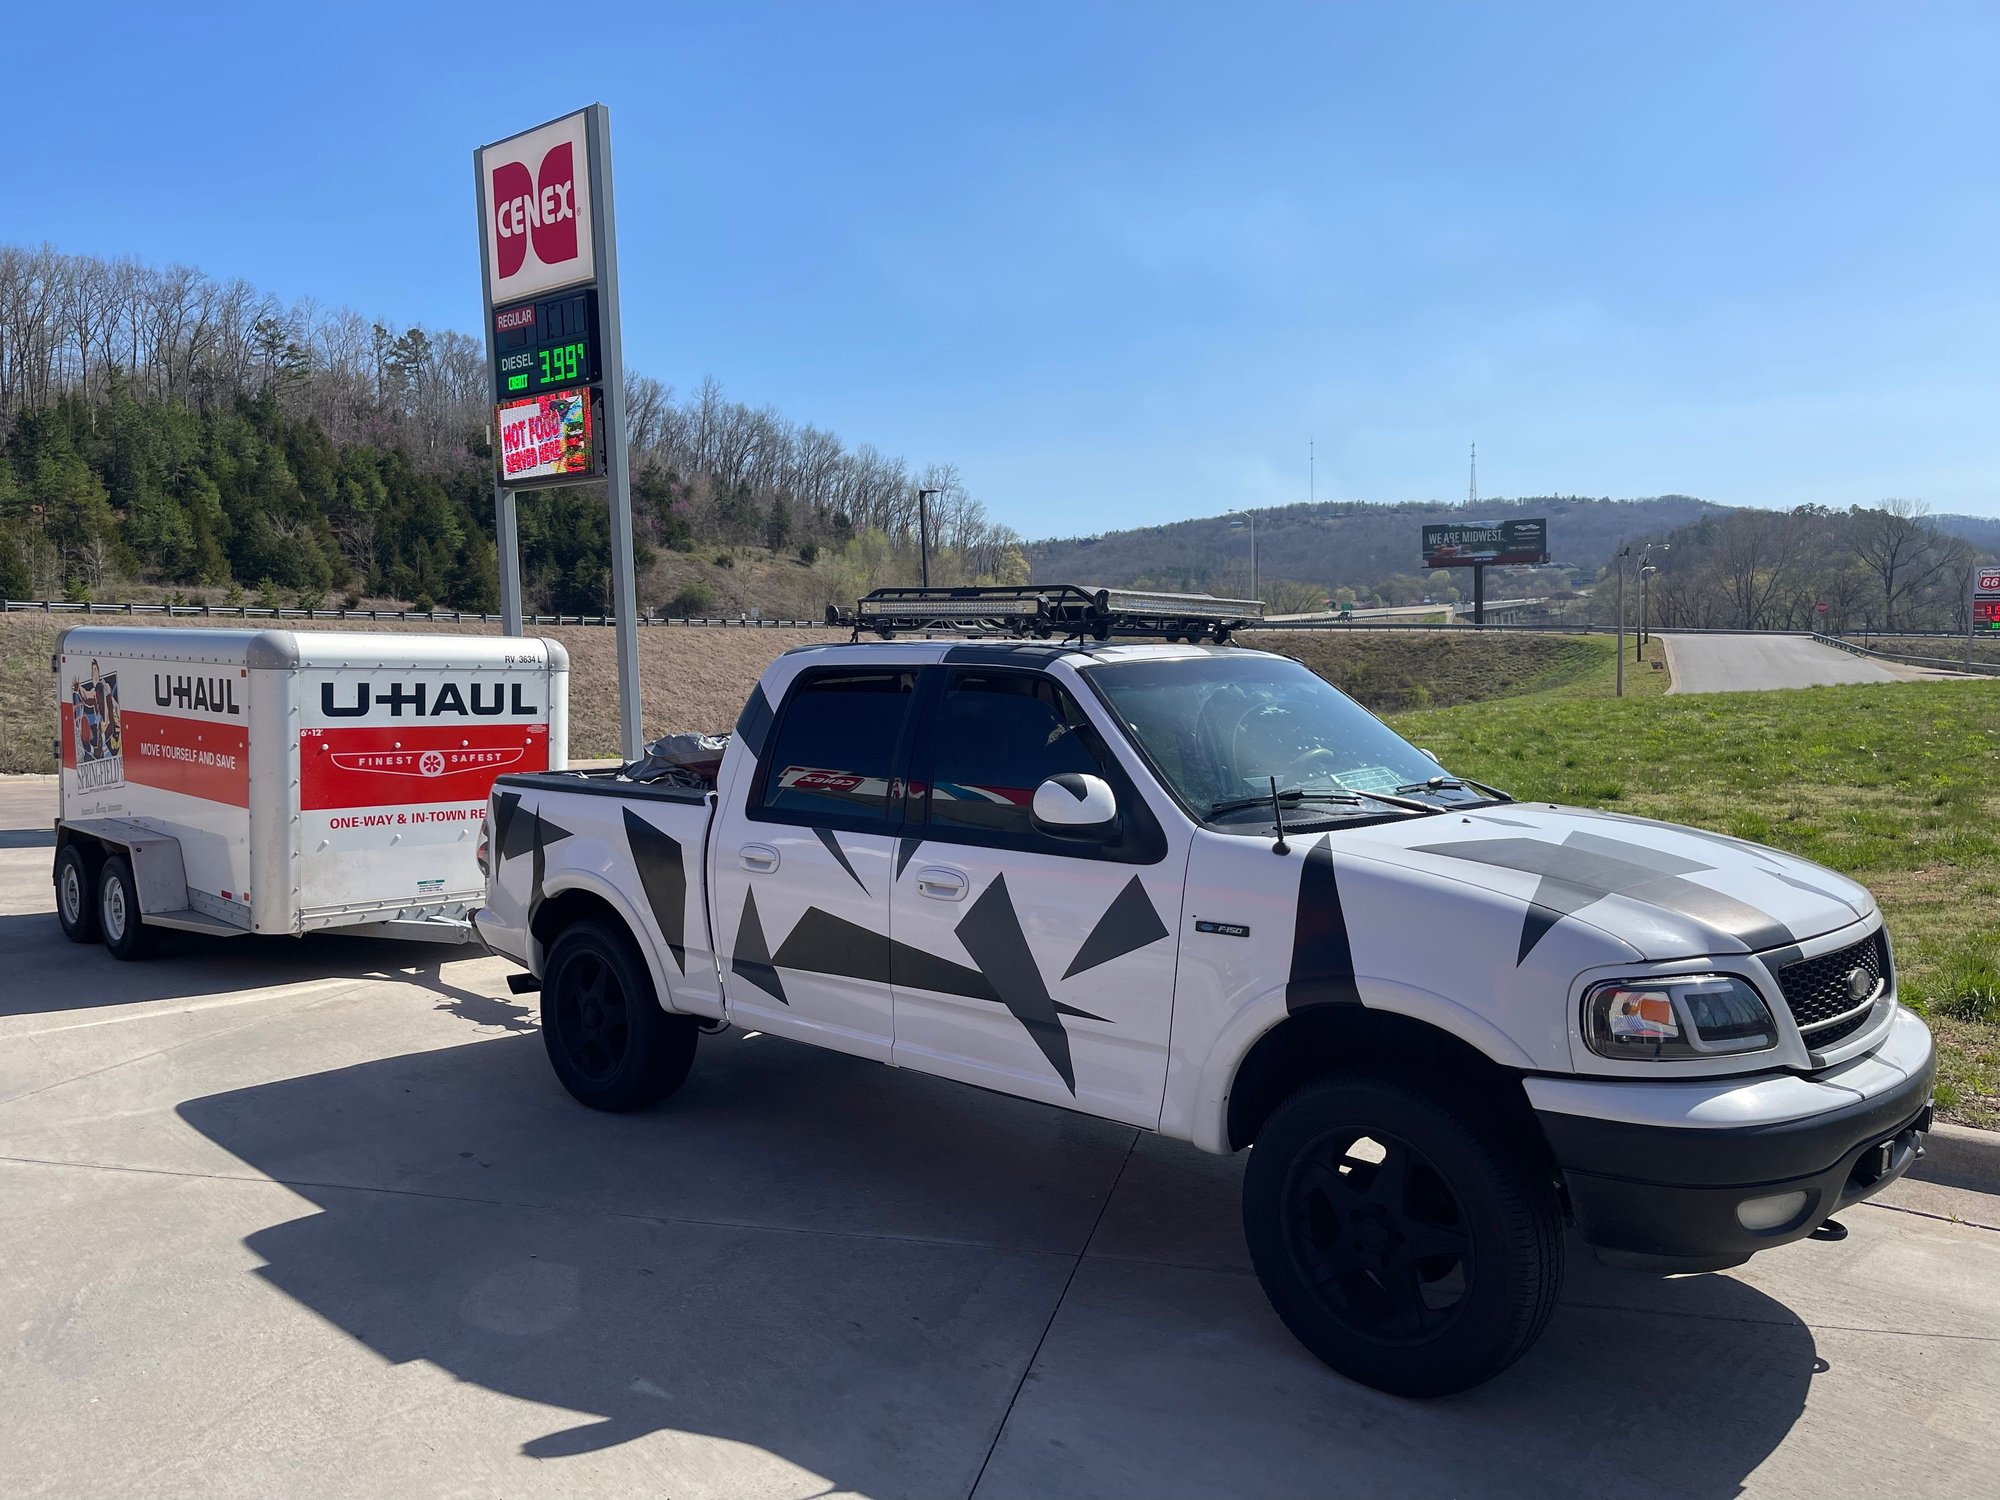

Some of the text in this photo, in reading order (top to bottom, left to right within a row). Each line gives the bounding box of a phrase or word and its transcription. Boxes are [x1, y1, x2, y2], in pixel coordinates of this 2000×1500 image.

[497, 180, 573, 238] CENEX
[498, 309, 532, 328] REGULAR
[502, 353, 534, 371] DIESEL
[503, 410, 560, 452] HOT FOOD
[538, 439, 562, 463] HERE
[1429, 533, 1442, 544] WE
[1443, 532, 1460, 543] ARE
[1462, 530, 1504, 543] MIDWEST.
[1983, 577, 1999, 587] 66
[504, 655, 542, 664] RV 3634 L
[154, 674, 240, 715] U-HAUL
[321, 682, 538, 717] U-HAUL
[140, 742, 236, 770] MOVE YOURSELF AND SAVE
[358, 753, 502, 766] FINEST SAFEST
[329, 814, 394, 829] ONE-WAY
[397, 813, 407, 824] &
[411, 810, 466, 823] IN-TOWN
[1217, 925, 1243, 934] F-150
